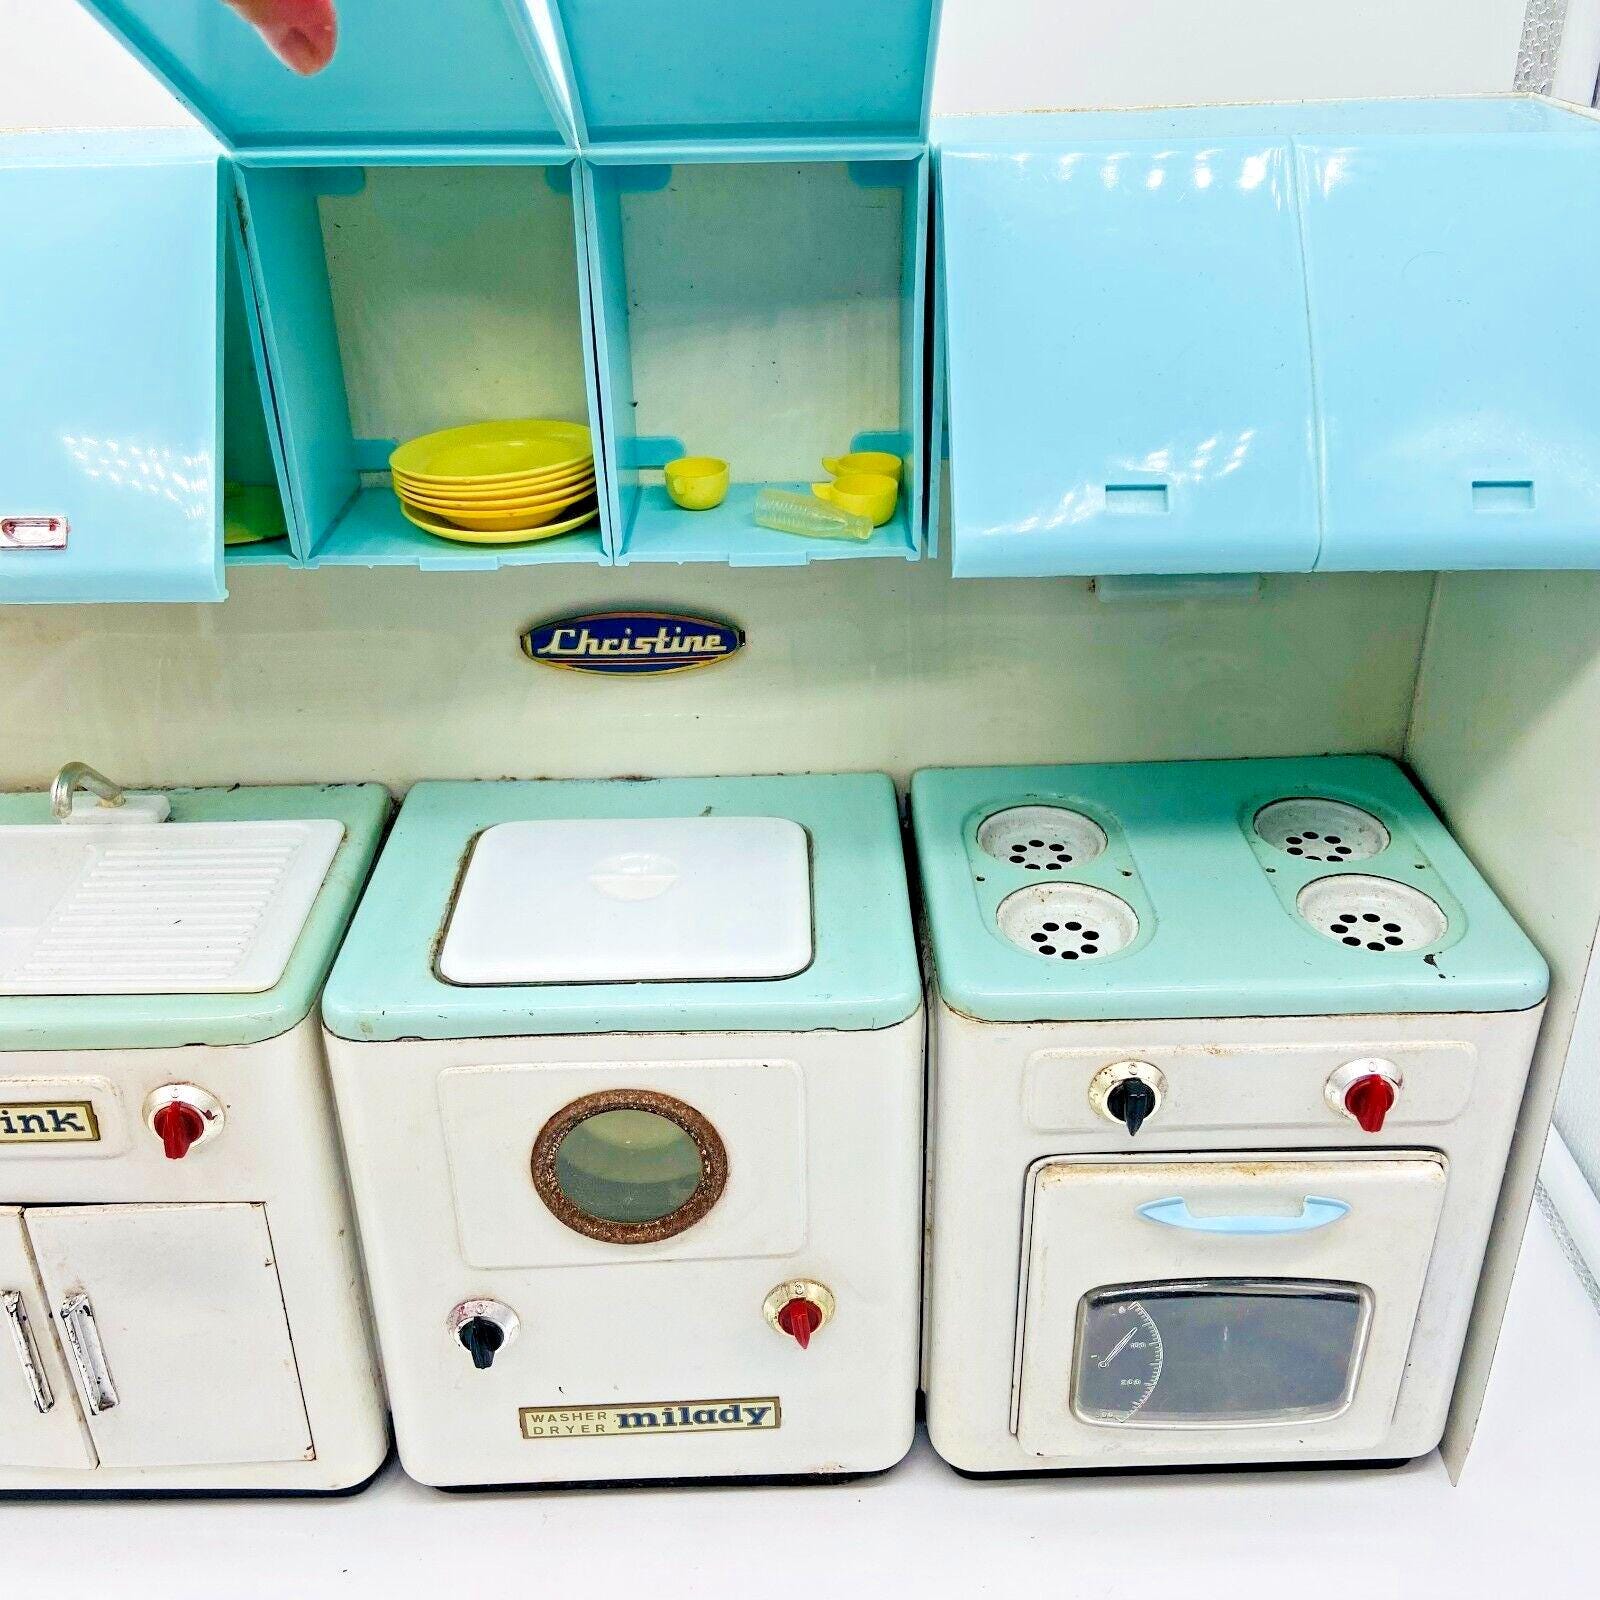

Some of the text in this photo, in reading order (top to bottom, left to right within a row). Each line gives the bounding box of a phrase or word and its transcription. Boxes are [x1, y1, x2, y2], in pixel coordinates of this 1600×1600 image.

[537, 627, 728, 655] Christine
[0, 1109, 86, 1134] ink
[531, 1411, 607, 1423] WASHER
[616, 1404, 772, 1429] milady
[533, 1424, 606, 1435] DRYER
